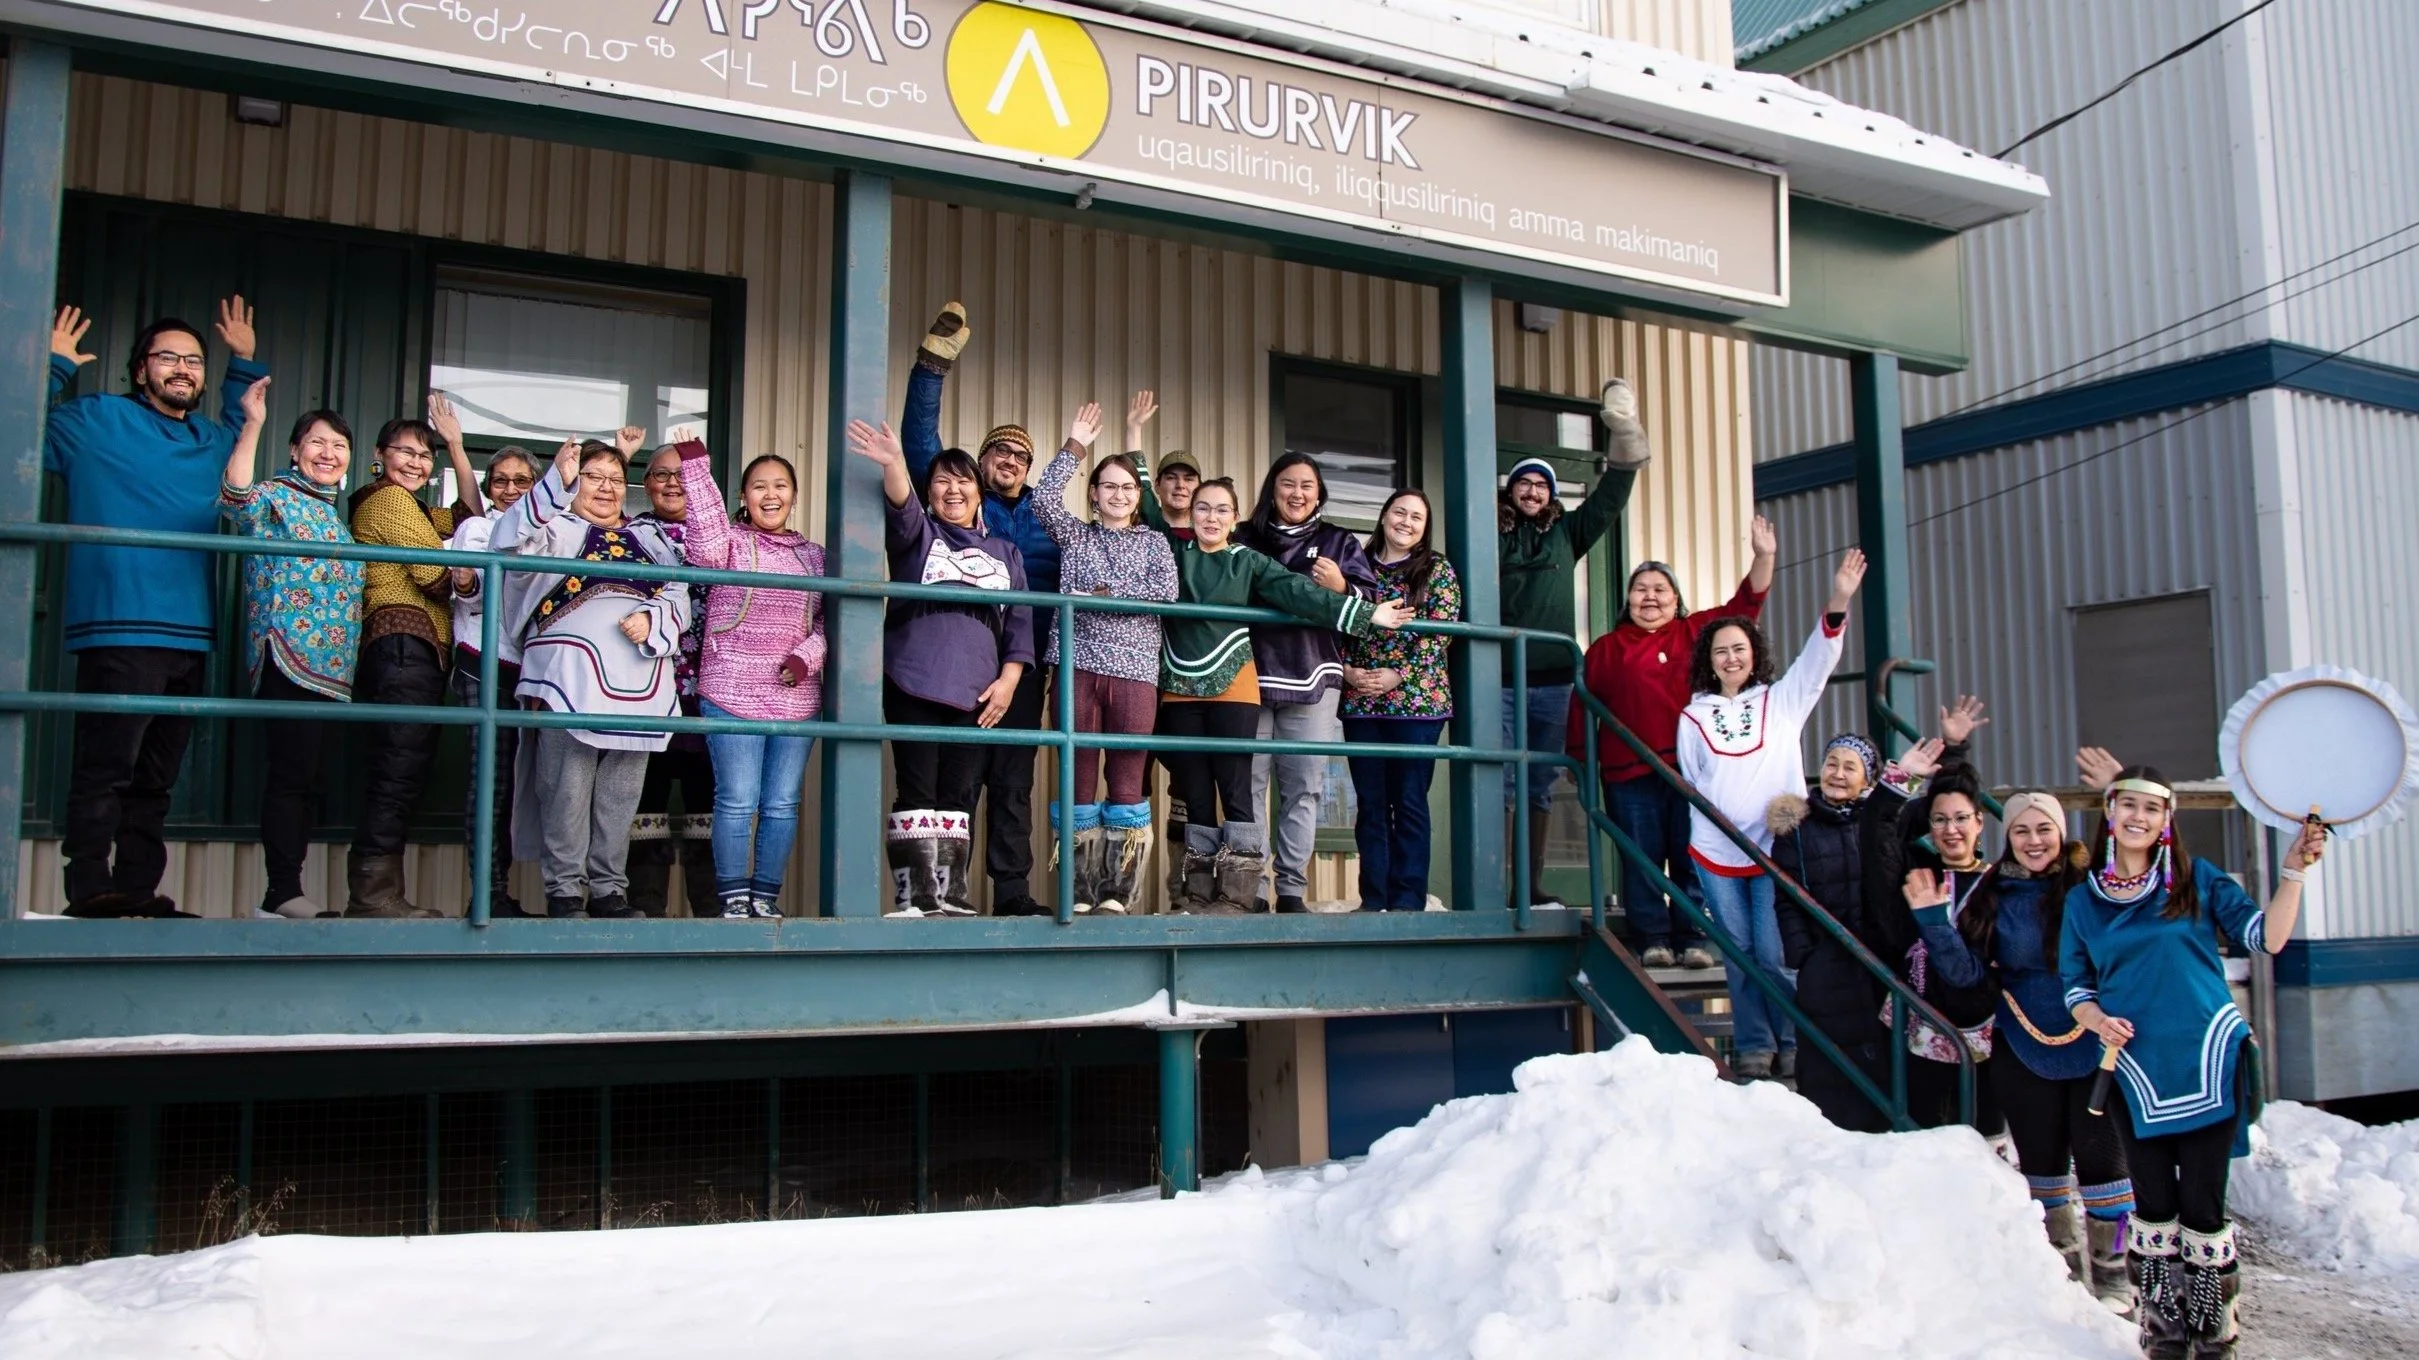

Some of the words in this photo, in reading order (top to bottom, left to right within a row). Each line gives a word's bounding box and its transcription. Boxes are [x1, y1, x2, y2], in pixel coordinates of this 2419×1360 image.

[1136, 53, 1423, 171] PIRURVIK
[1137, 133, 1320, 196] uqausiliriniq,
[1336, 164, 1495, 231] iliqqusiliriniq
[1509, 207, 1585, 241] amma
[1596, 224, 1719, 275] makimaniq
